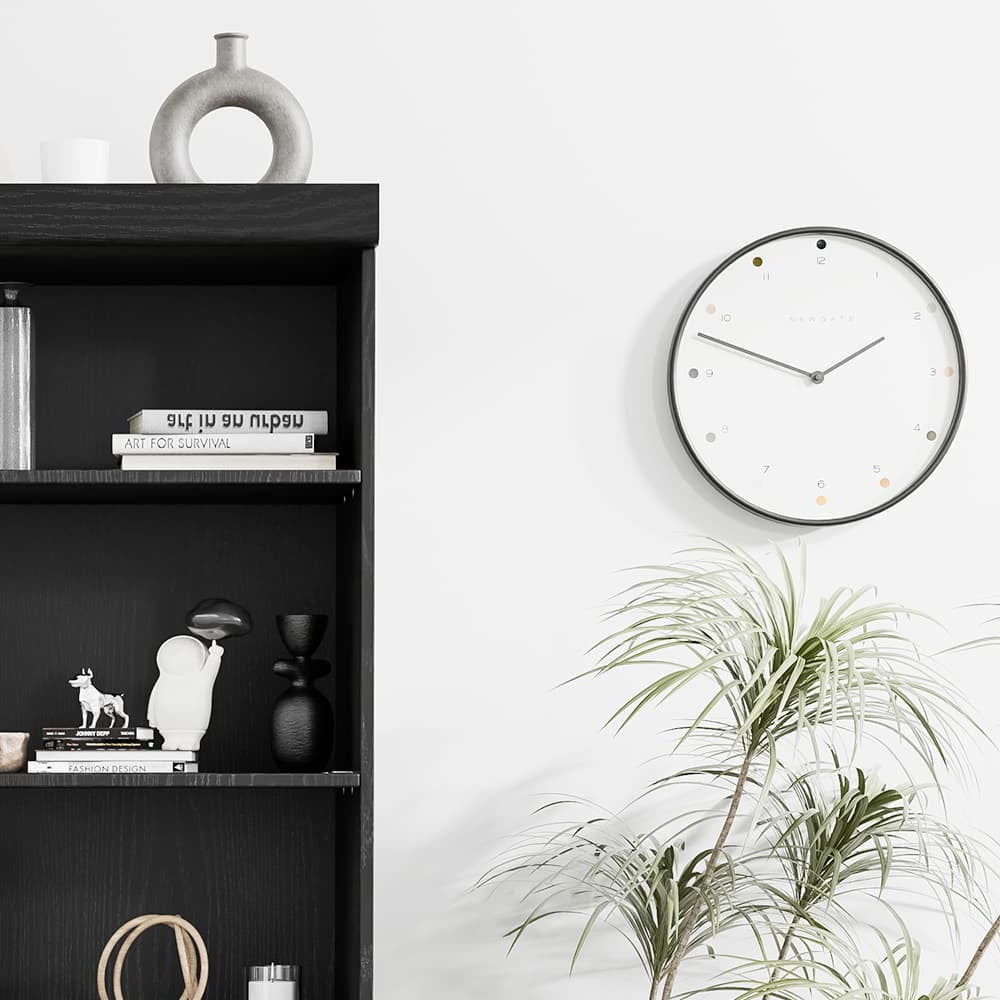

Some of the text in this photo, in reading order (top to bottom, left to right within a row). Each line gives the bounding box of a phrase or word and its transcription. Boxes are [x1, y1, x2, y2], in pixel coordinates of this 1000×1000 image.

[816, 256, 827, 265] 12
[763, 272, 770, 281] 11
[721, 313, 732, 322] 10
[913, 312, 922, 321] 2
[705, 368, 714, 377] 9
[929, 367, 937, 377] 3
[721, 425, 729, 434] 8
[913, 423, 921, 432] 4
[124, 438, 231, 449] ART FOR SURVIVAL
[762, 465, 770, 474] 7
[872, 465, 880, 474] 5
[817, 480, 826, 489] 6
[68, 764, 147, 773] FASHION DESIGN
